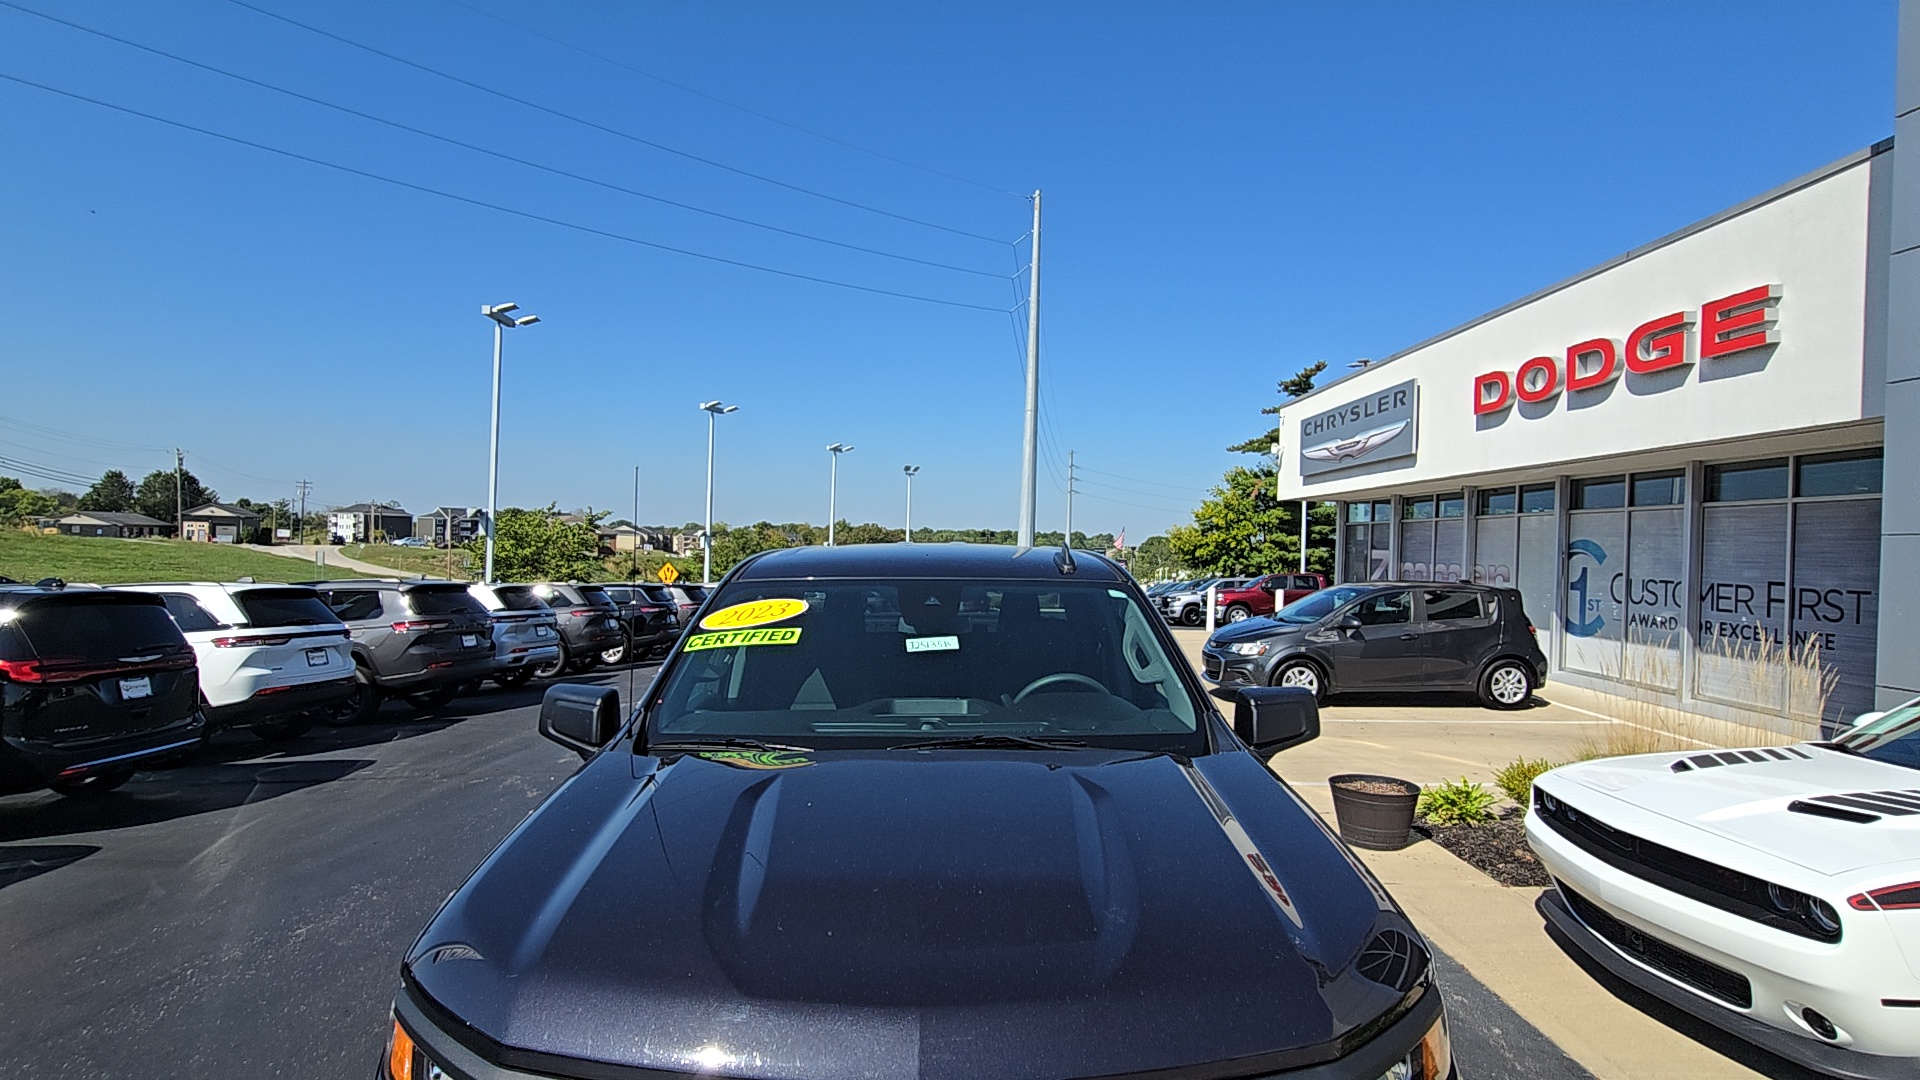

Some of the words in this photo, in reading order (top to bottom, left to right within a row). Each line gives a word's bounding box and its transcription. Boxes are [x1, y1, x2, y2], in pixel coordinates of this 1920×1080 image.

[1473, 284, 1781, 415] DODGE
[1303, 389, 1408, 437] CHRYSLER
[1371, 549, 1511, 586] Zmmer
[717, 602, 792, 626] 2023
[1766, 580, 1872, 625] FIRST
[688, 630, 797, 649] CERTIFIED
[1628, 613, 1679, 631] AWARD
[1719, 621, 1836, 651] EXCELLNCE
